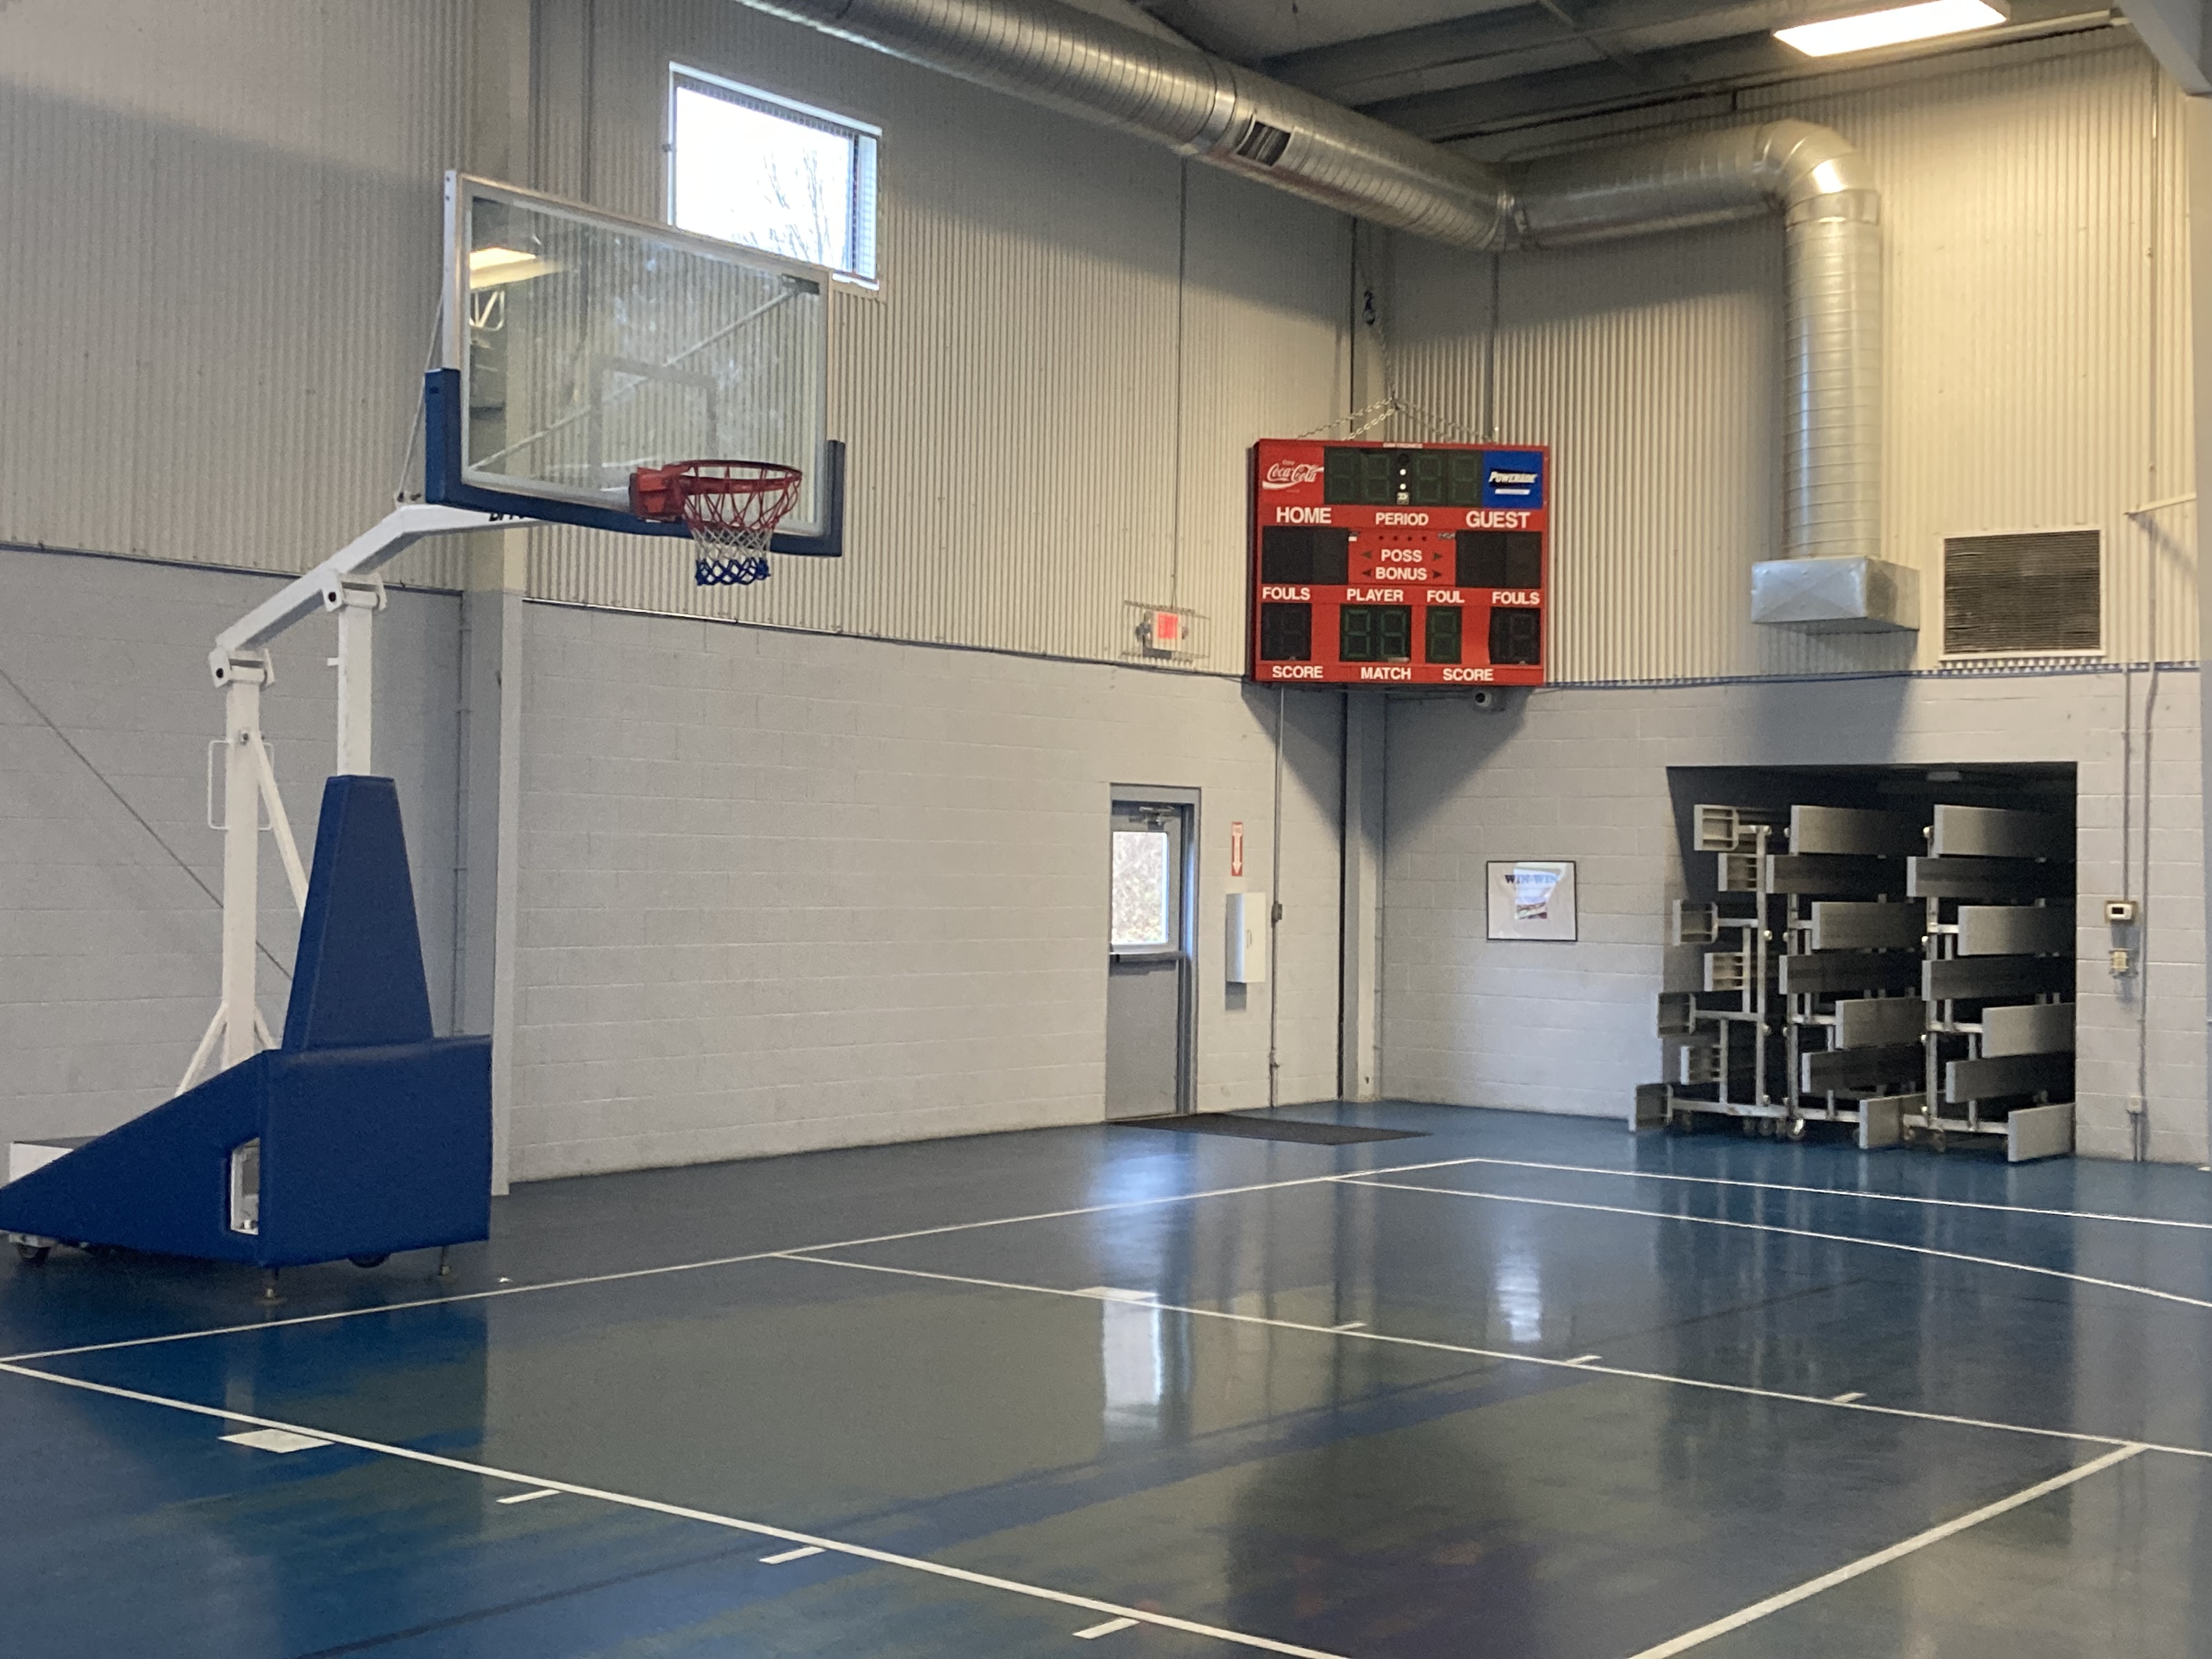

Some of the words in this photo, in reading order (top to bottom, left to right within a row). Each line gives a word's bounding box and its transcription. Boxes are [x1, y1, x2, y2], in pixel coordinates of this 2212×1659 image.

[1276, 506, 1332, 524] HOME
[1375, 512, 1429, 526] PERIOD
[1465, 510, 1531, 528] GUEST
[1381, 549, 1423, 562] POSS
[1375, 567, 1427, 580] BONUS
[1262, 586, 1311, 601] FOULS
[1347, 588, 1404, 602] PLAYER
[1427, 590, 1465, 603] FOUL
[1492, 591, 1540, 605] FOULS
[1272, 665, 1323, 679] SCORE
[1361, 667, 1412, 680] MATCH
[1443, 668, 1494, 681] SCORE
